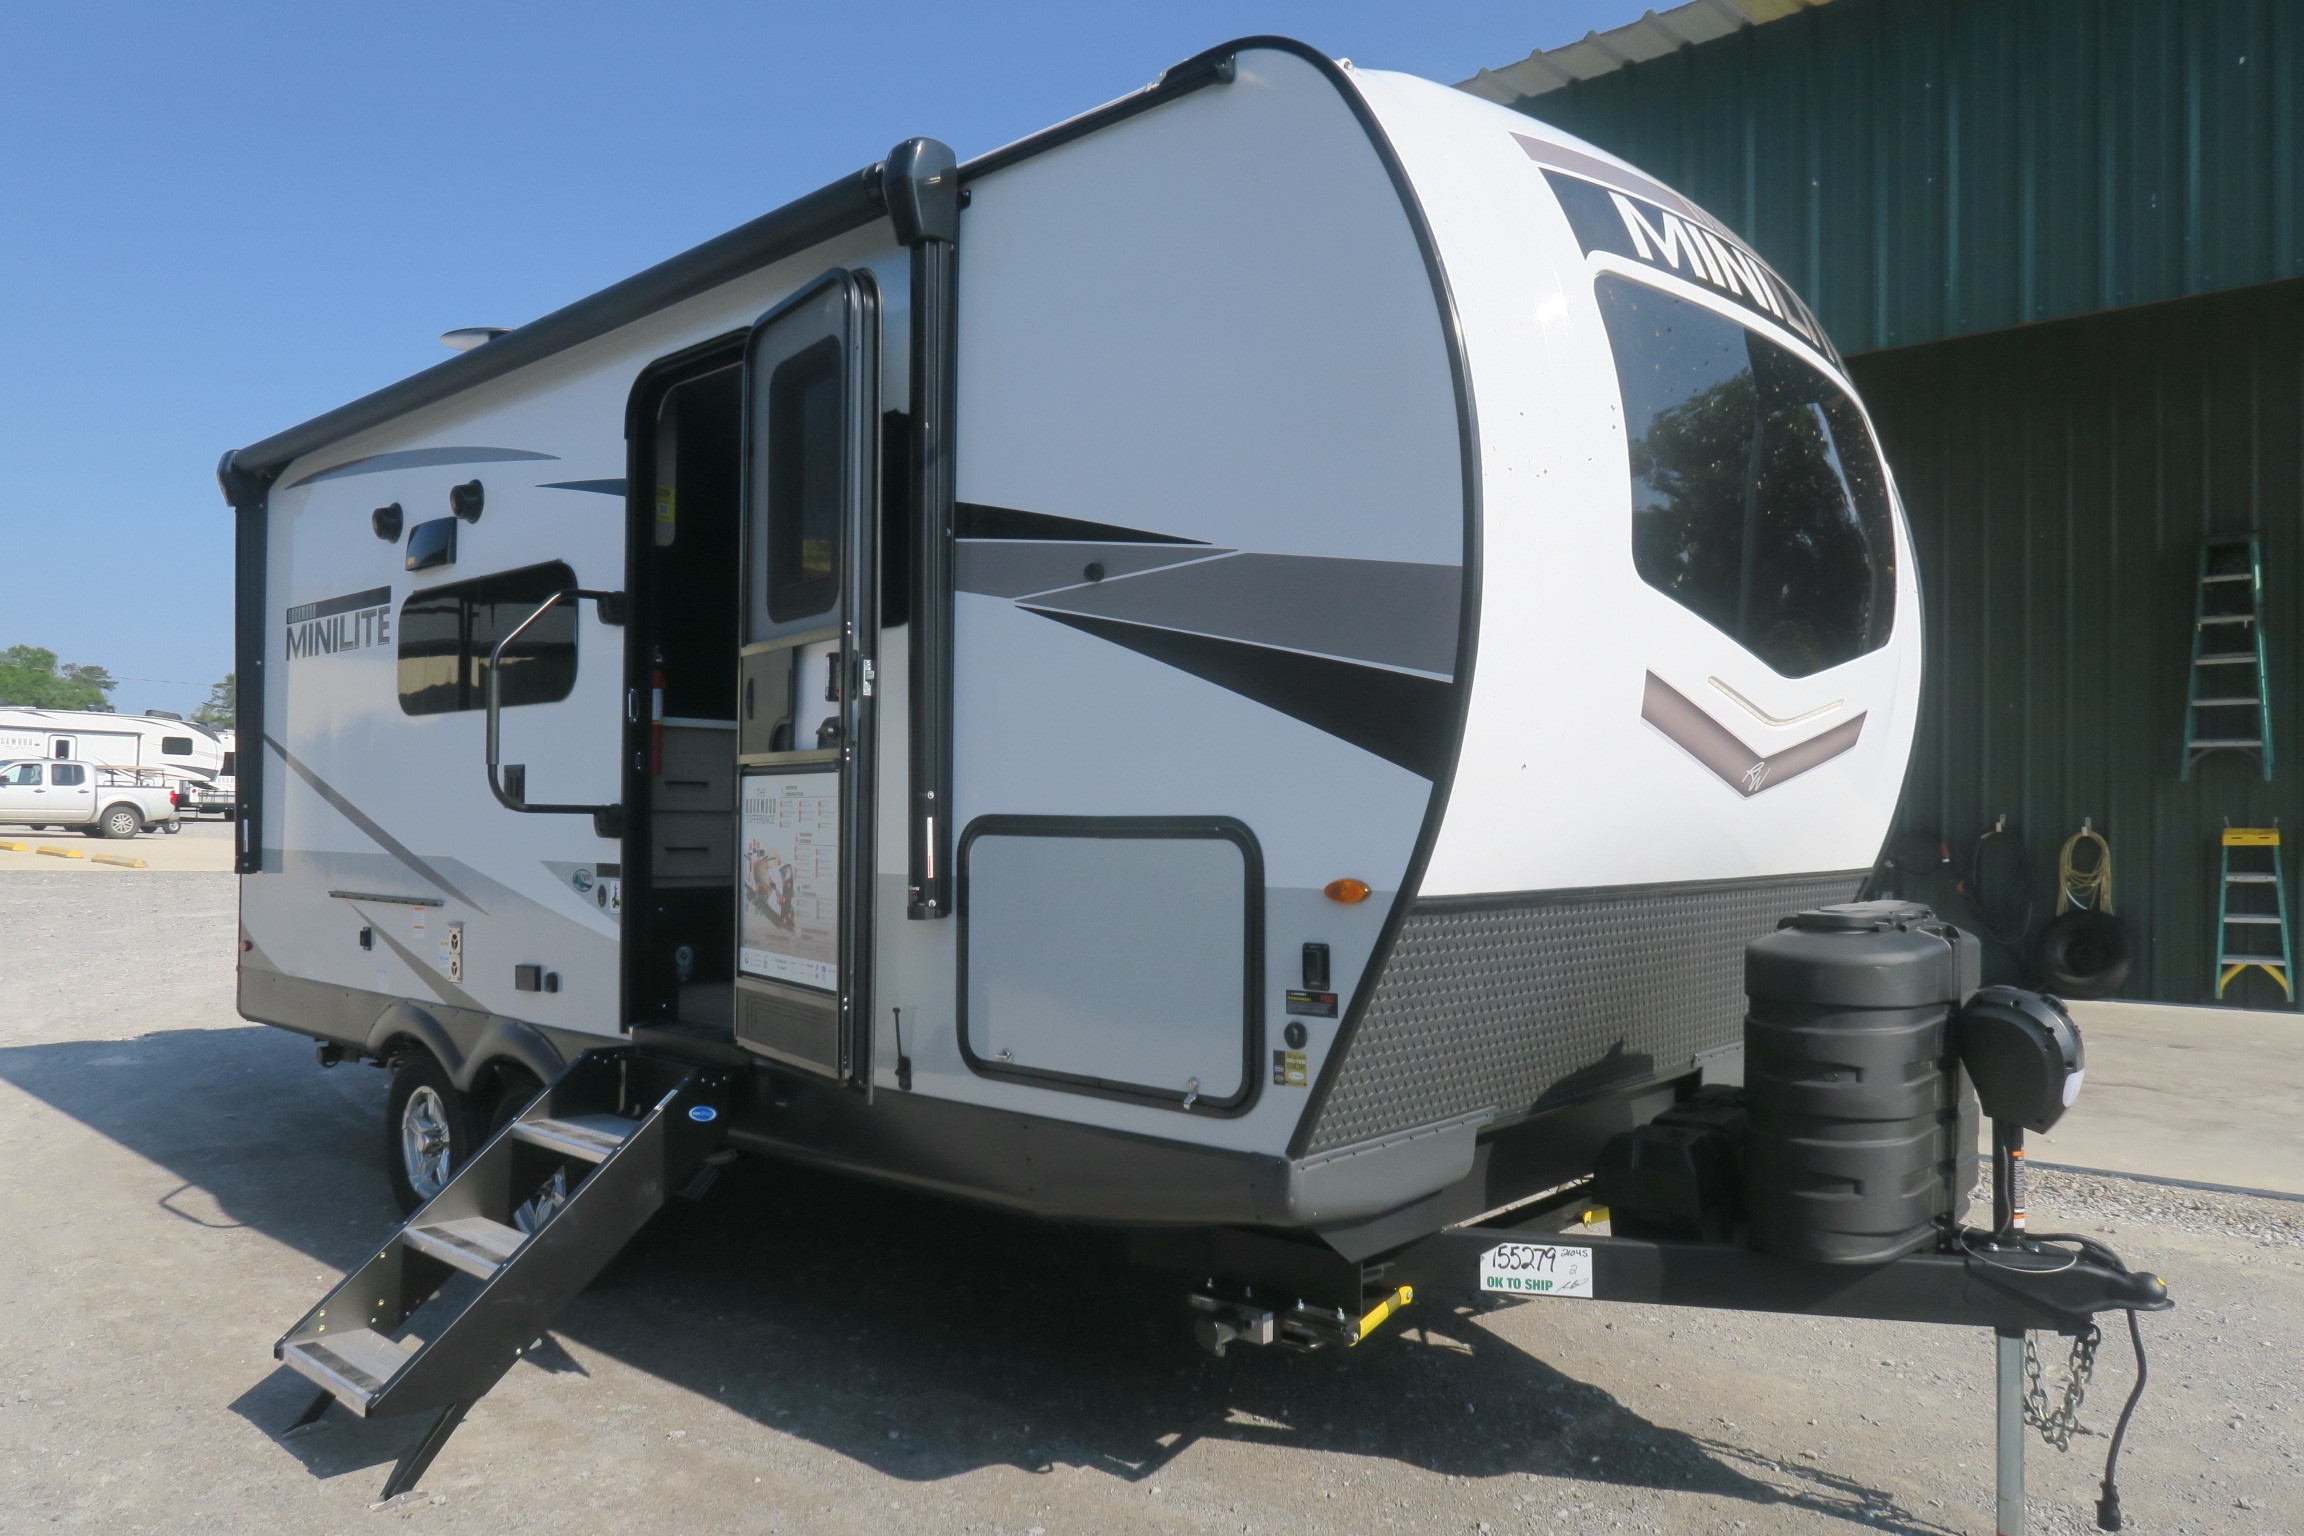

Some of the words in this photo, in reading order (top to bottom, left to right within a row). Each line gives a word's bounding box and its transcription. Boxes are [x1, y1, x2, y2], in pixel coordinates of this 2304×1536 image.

[286, 605, 391, 661] MINILITE
[1492, 1244, 1557, 1273] 155279
[1486, 1276, 1504, 1289] OK
[1506, 1277, 1521, 1290] TO
[1525, 1279, 1554, 1291] SHIP
